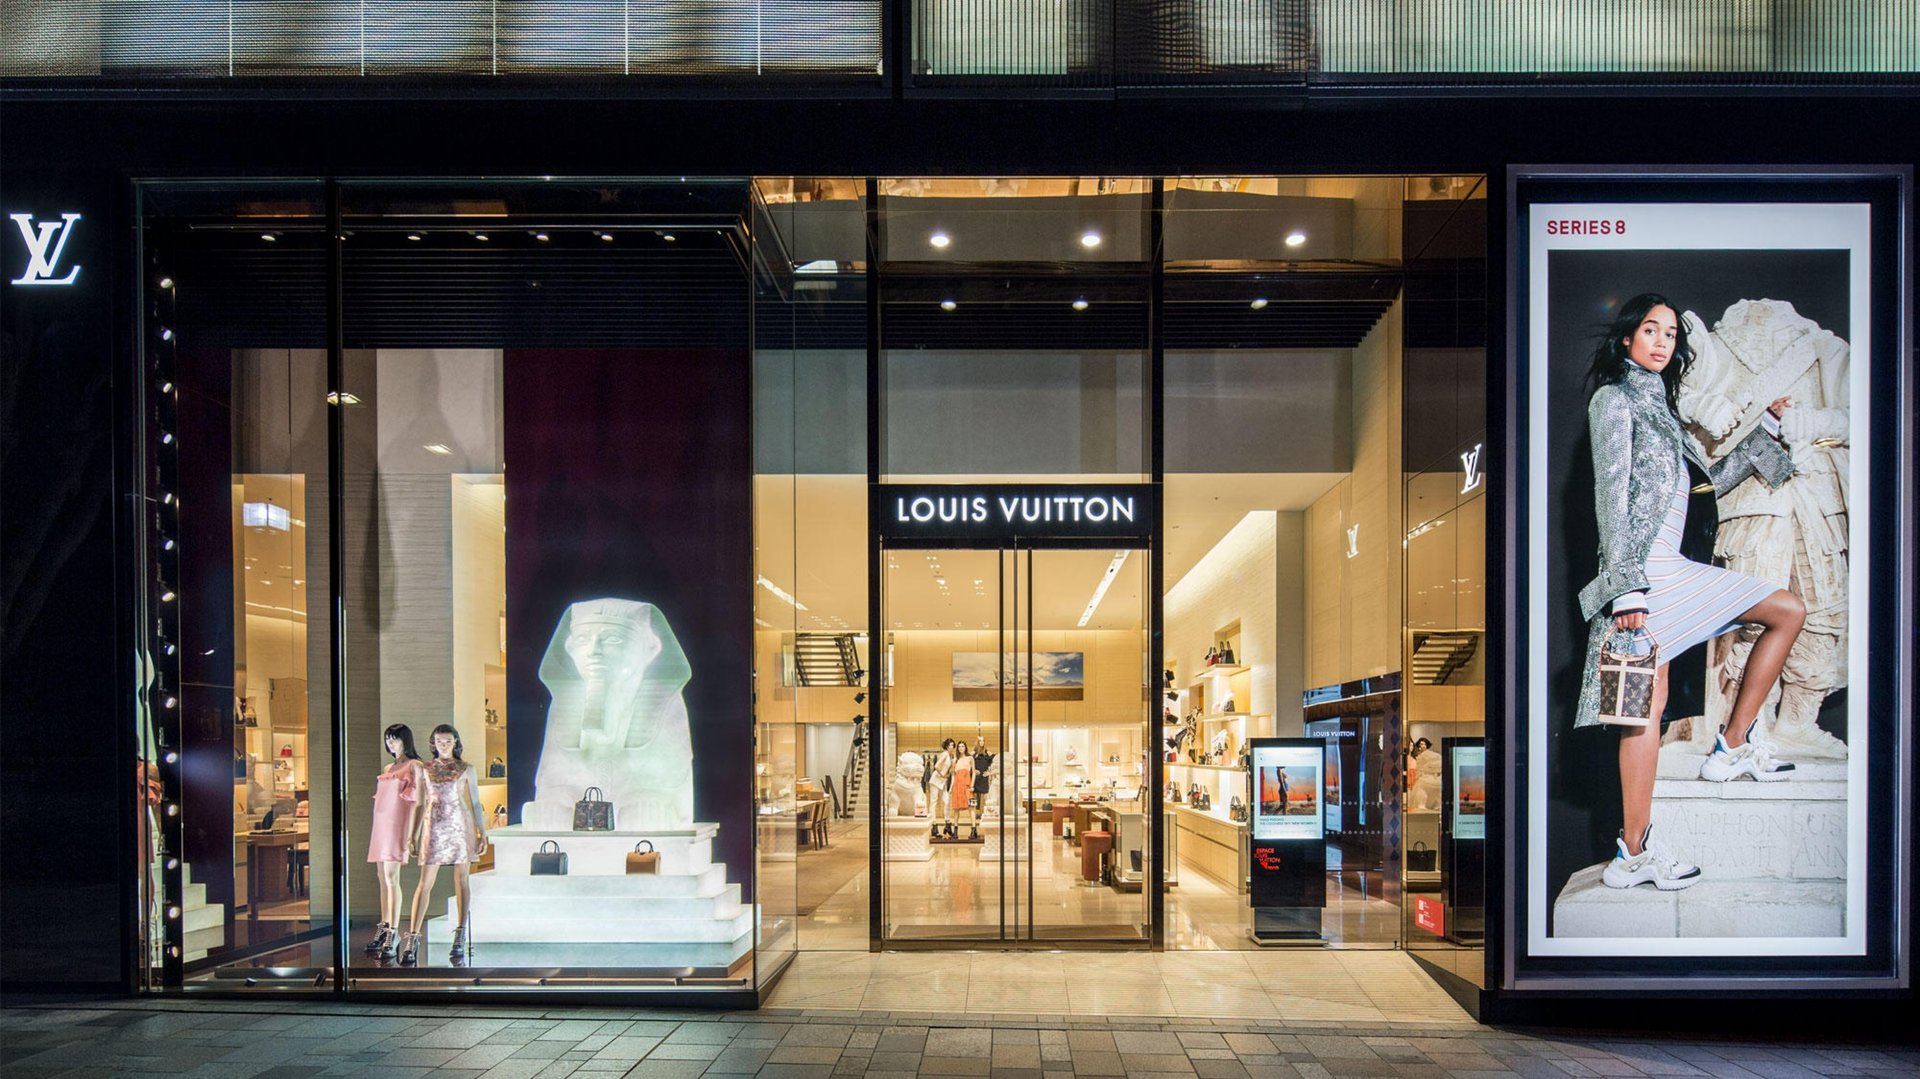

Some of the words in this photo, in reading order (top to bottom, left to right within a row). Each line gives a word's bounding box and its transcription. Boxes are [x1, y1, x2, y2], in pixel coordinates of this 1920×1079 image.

[1547, 220, 1611, 235] SERIES
[1615, 220, 1626, 235] 8
[10, 213, 81, 285] LV
[898, 498, 987, 522] LOUIS
[998, 497, 1134, 523] VUITTON
